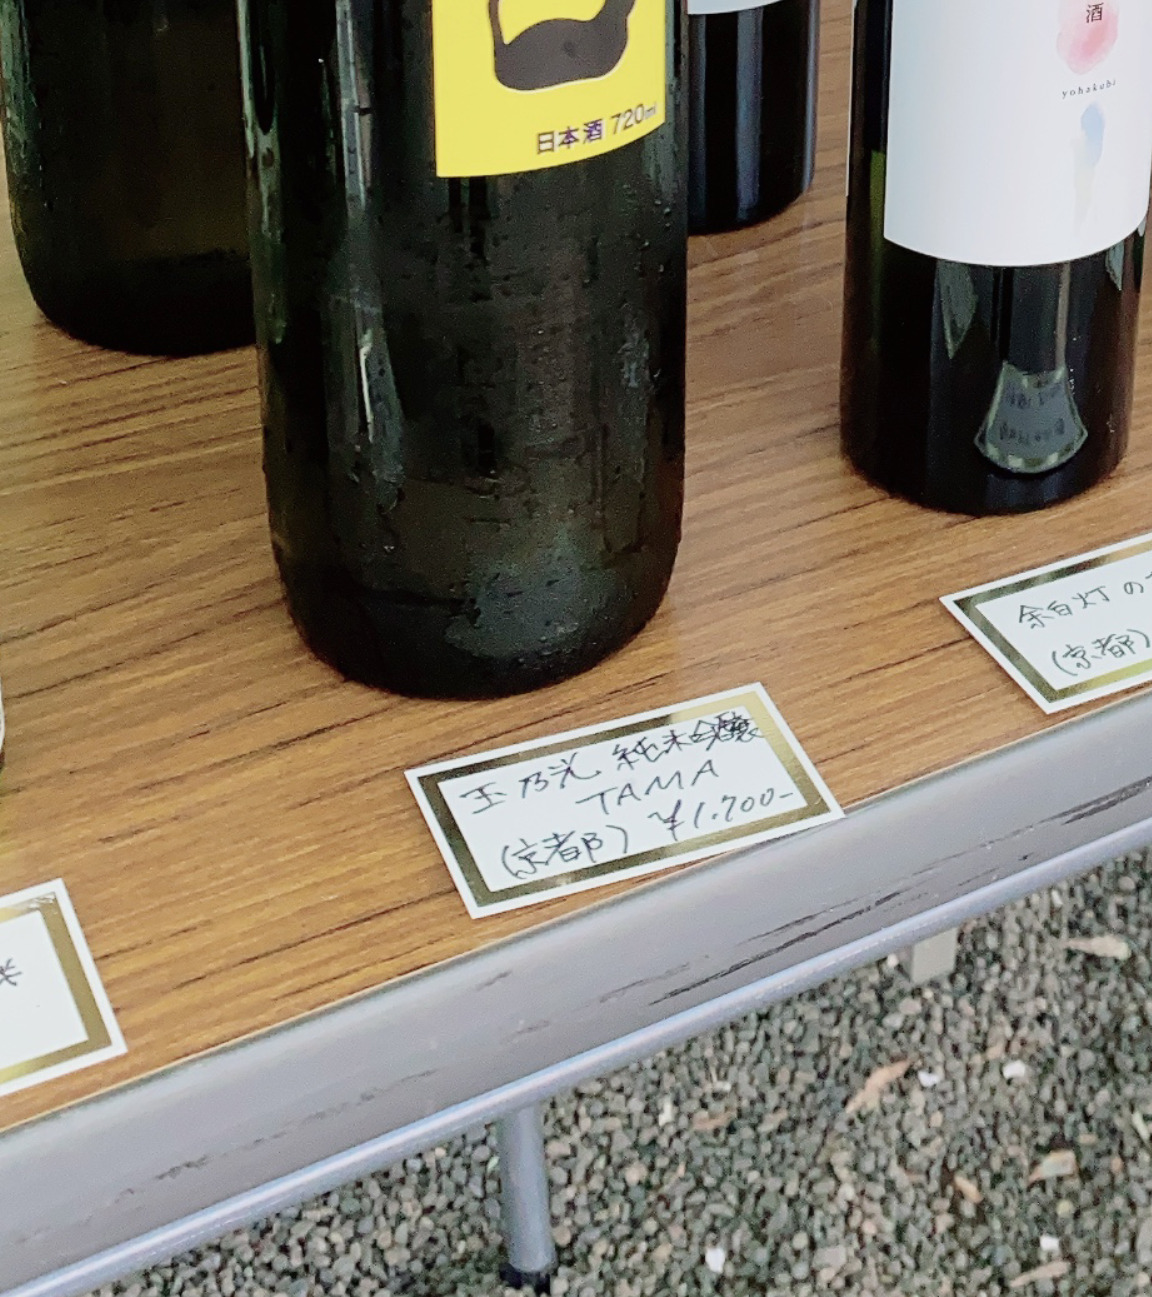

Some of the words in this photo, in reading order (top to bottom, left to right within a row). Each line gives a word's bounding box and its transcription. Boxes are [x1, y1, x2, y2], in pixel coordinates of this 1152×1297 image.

[537, 118, 604, 155] 日本酒
[575, 759, 719, 816] TAMA
